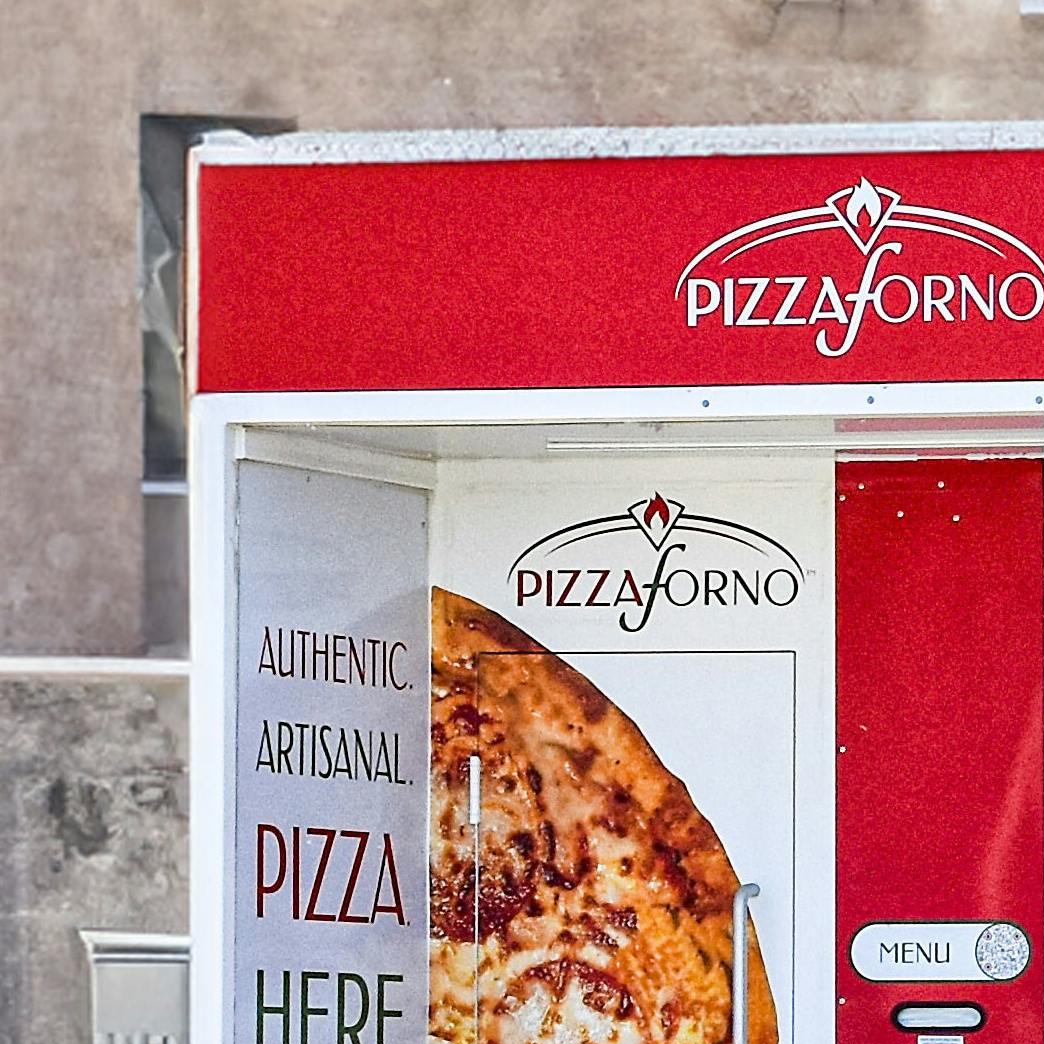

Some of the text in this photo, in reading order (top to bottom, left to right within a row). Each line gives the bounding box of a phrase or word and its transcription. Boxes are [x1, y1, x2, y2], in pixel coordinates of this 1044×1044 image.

[258, 626, 414, 690] AUTHENTIC.
[255, 719, 414, 786] ARTISANAL.
[256, 823, 410, 926] PIZZA.
[879, 942, 951, 964] MENU
